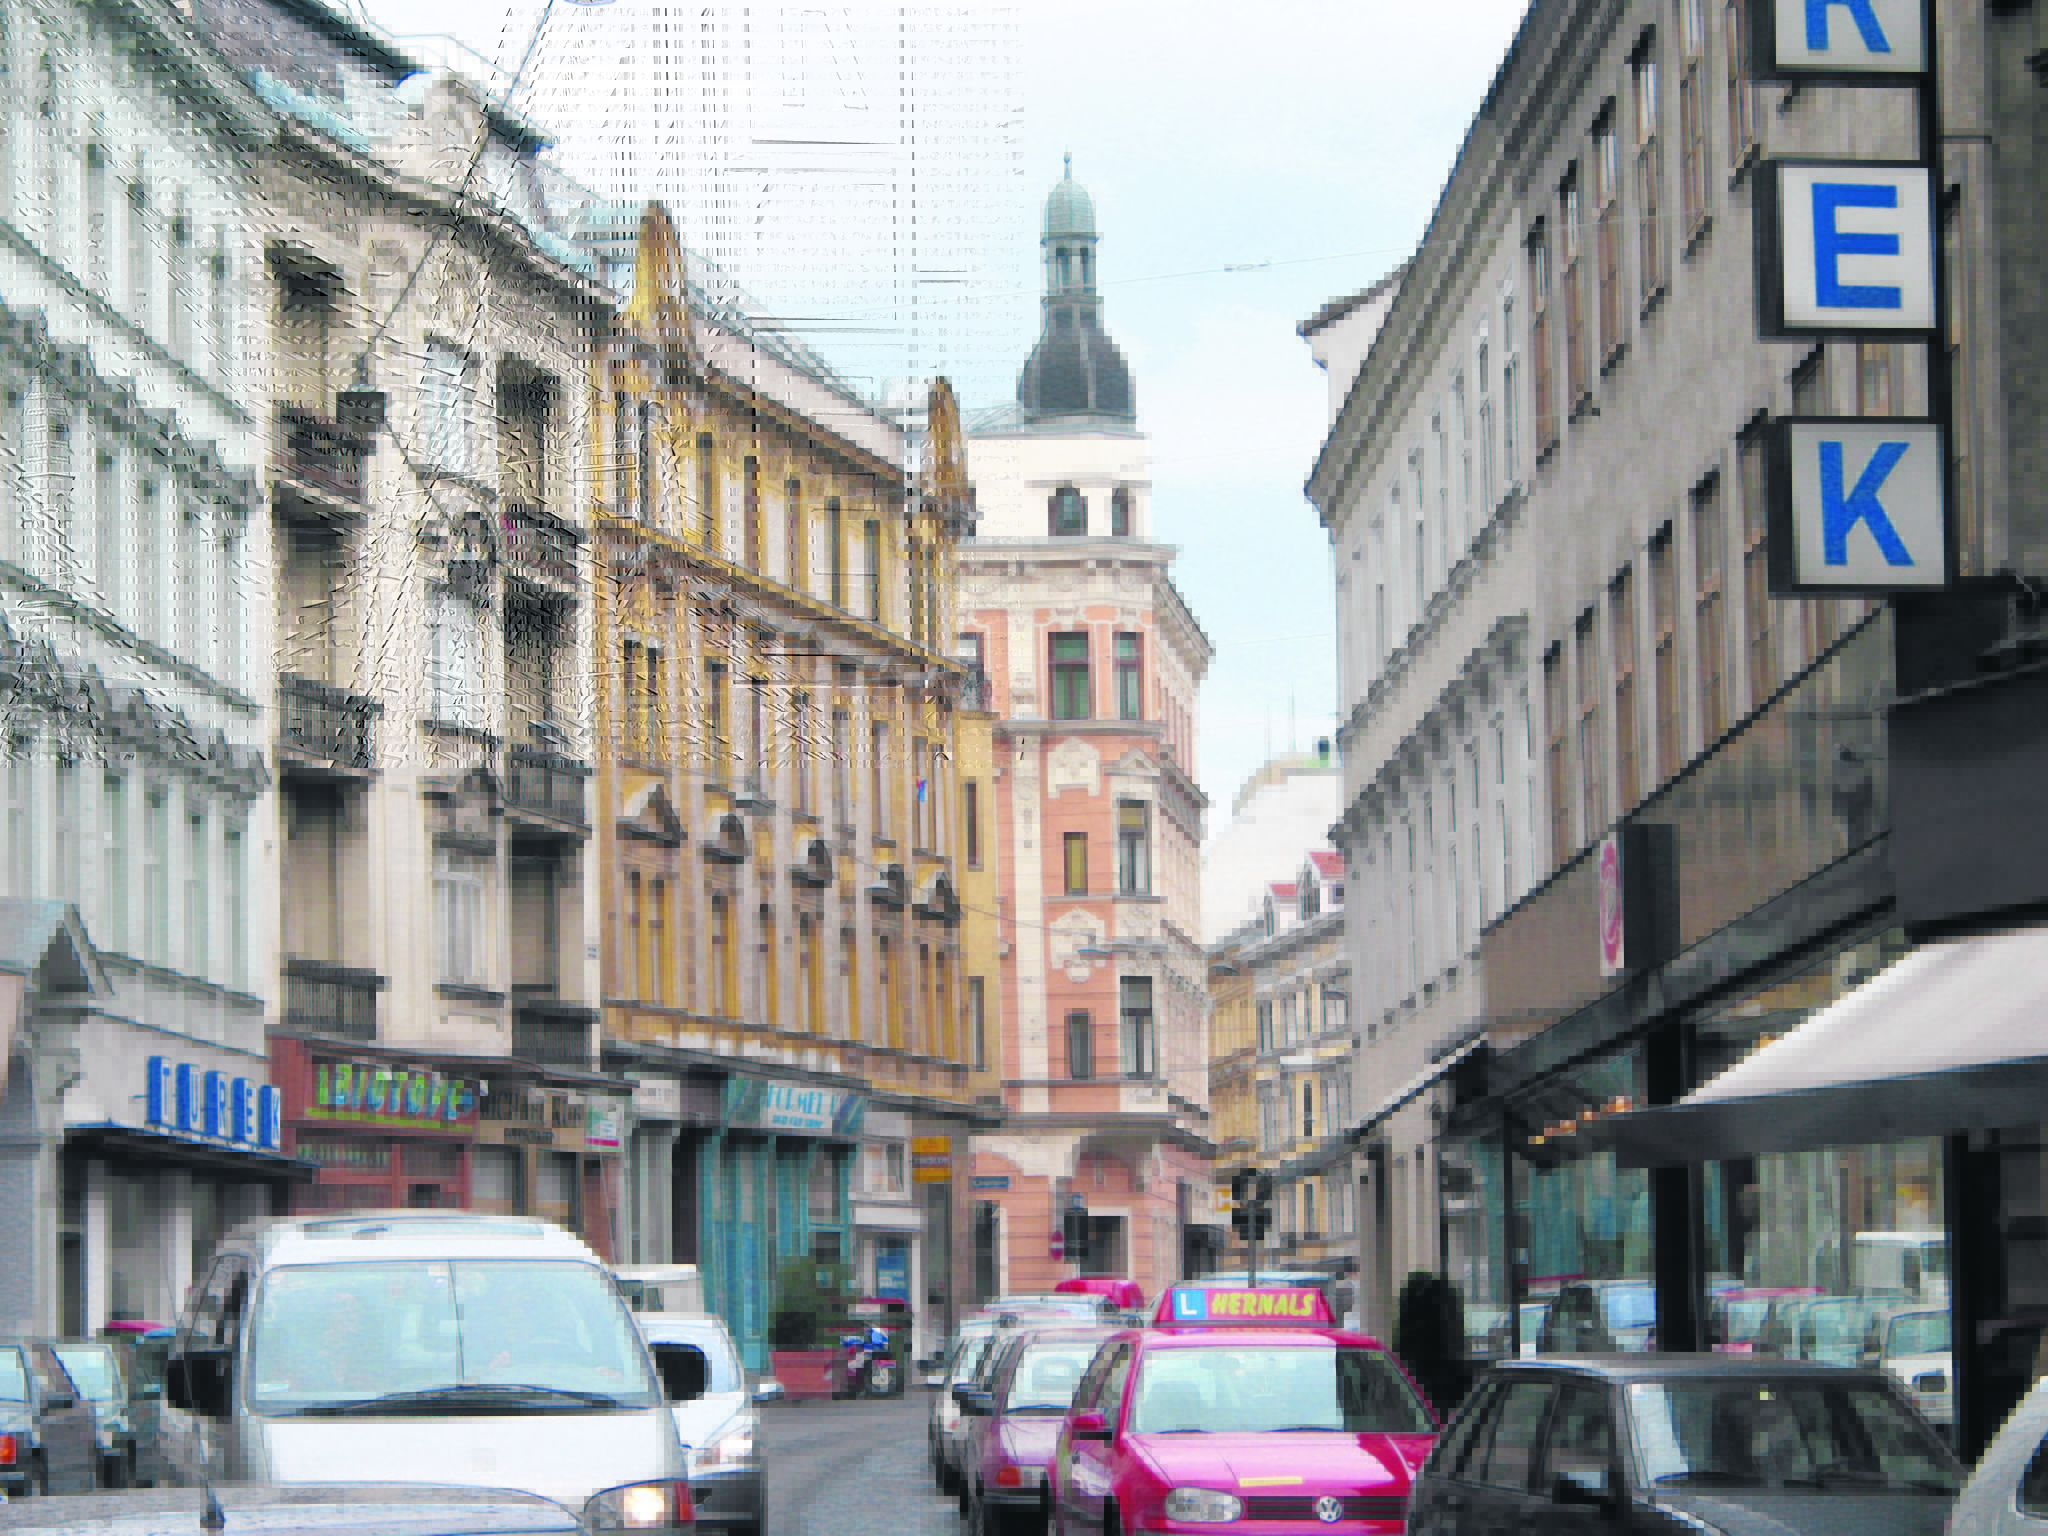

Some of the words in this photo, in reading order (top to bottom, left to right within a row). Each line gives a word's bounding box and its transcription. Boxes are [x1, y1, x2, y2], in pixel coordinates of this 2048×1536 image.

[159, 1064, 281, 1143] TUREK
[1179, 1292, 1198, 1316] L
[1211, 1291, 1315, 1317] HERNALS
